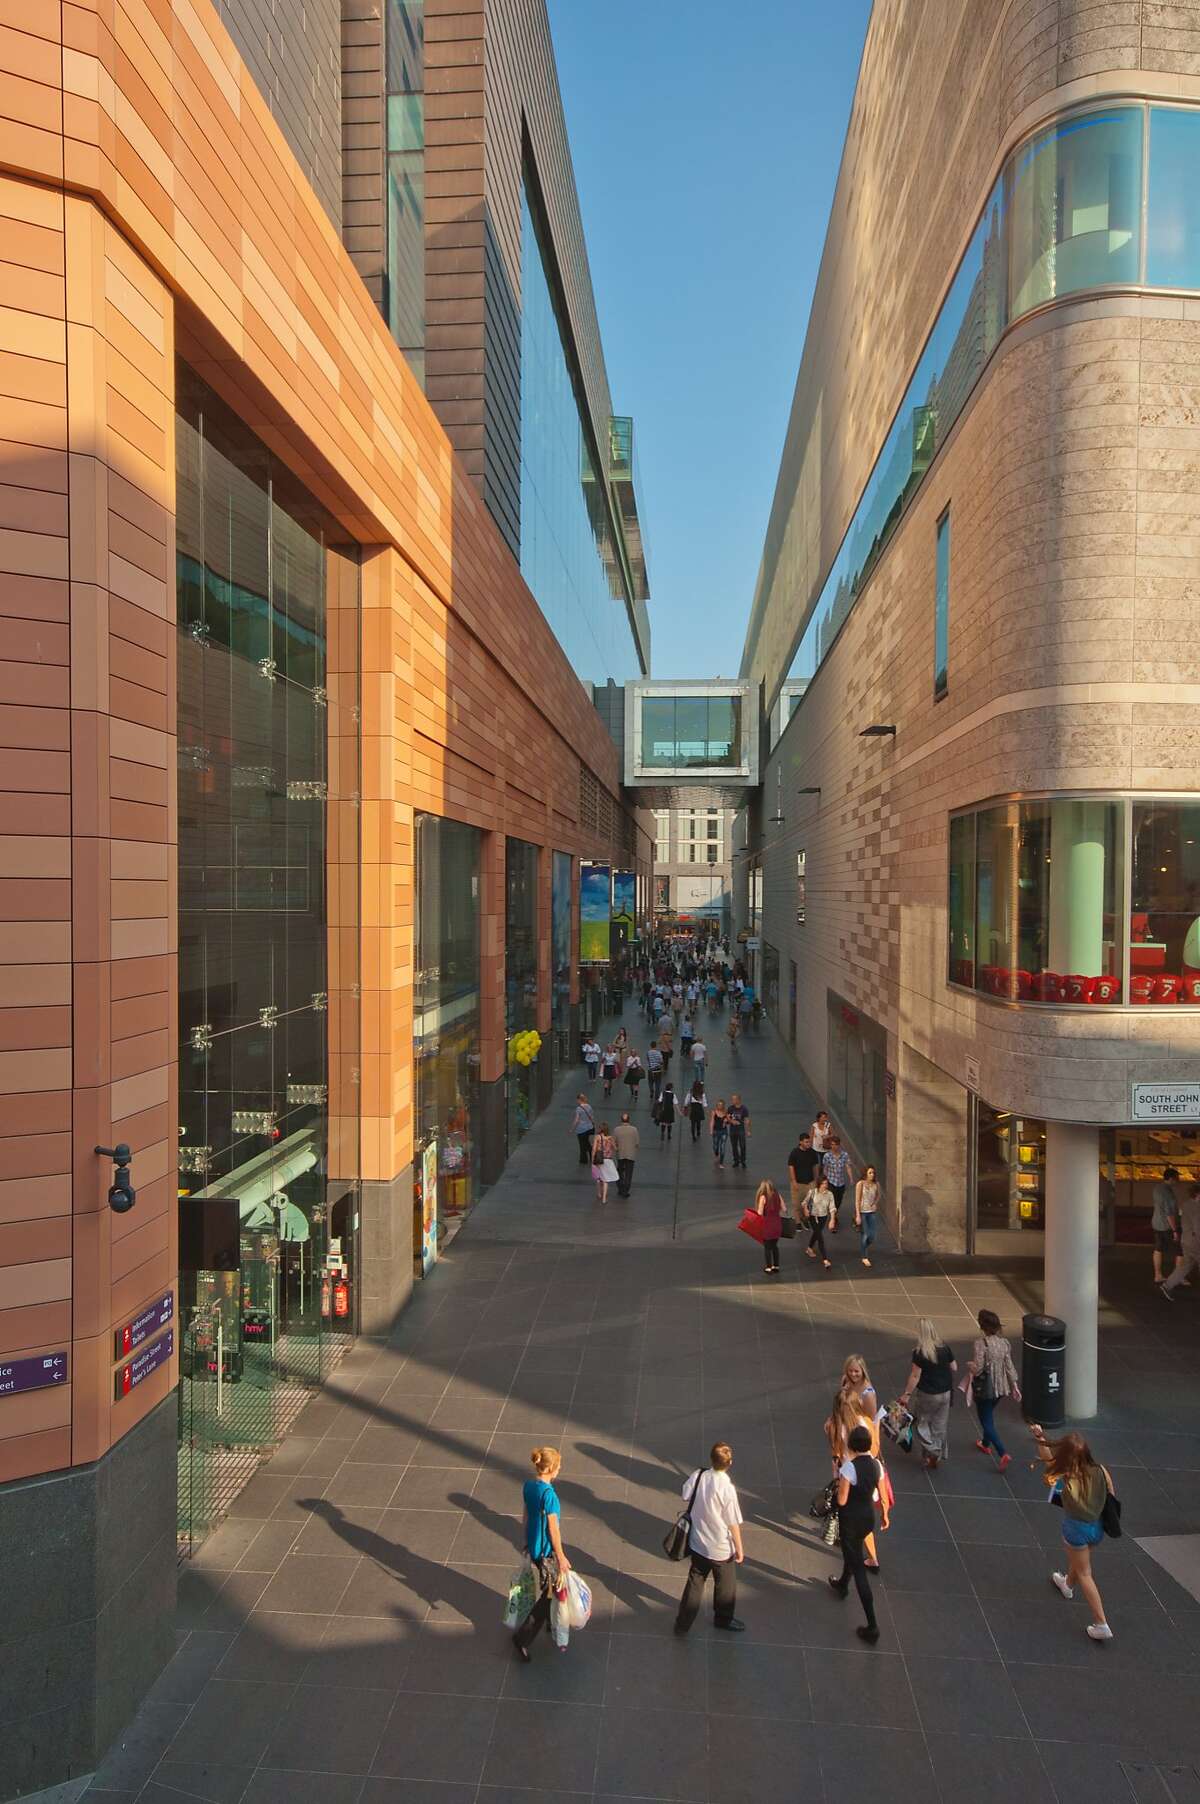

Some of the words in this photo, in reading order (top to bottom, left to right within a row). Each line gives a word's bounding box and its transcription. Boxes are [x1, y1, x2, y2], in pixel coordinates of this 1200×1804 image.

[1162, 983, 1173, 997] 7
[1139, 1095, 1171, 1104] SOUTH
[1173, 1094, 1199, 1103] JOHN
[1151, 1104, 1187, 1113] STREET
[244, 1323, 264, 1334] hmv
[1048, 1372, 1060, 1388] 1
